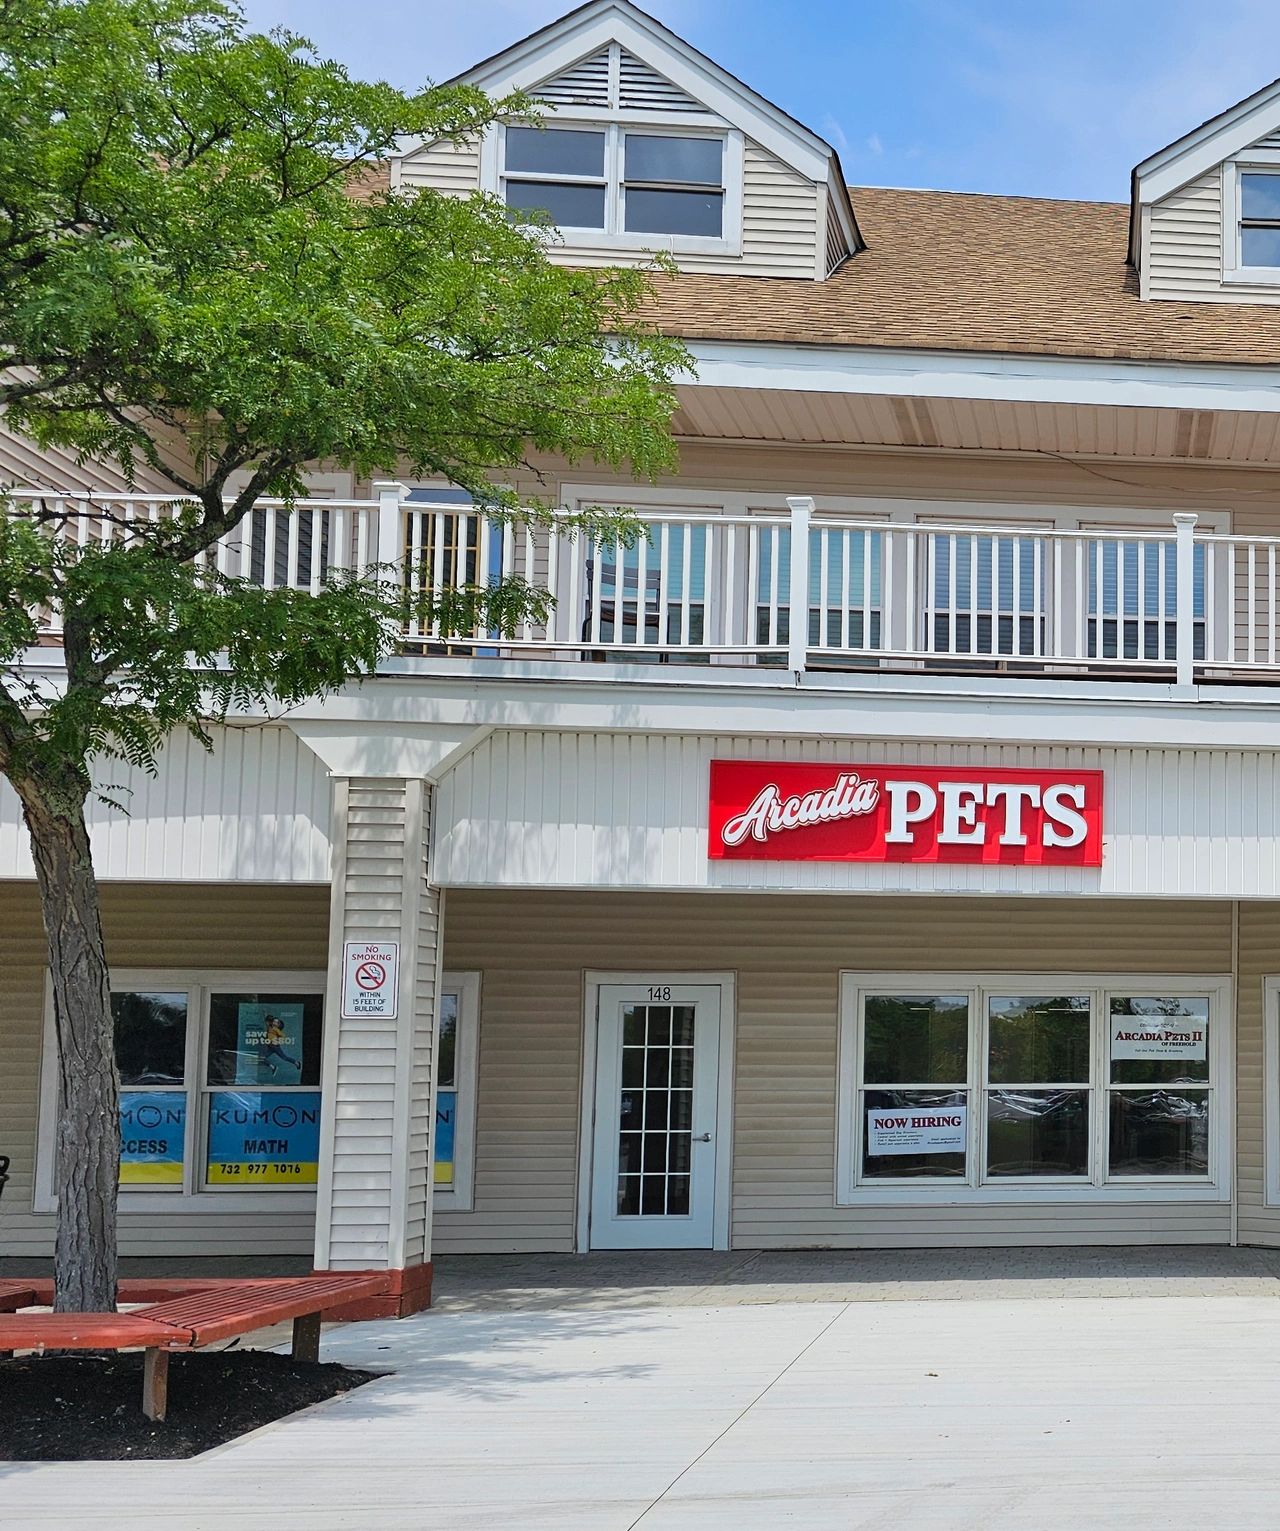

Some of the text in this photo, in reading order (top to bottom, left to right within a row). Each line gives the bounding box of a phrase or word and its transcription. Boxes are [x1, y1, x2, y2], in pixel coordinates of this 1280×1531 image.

[721, 772, 1088, 848] Arcadia PETS
[351, 953, 392, 961] SMOKING
[647, 986, 671, 1001] 148
[245, 1038, 259, 1046] up
[260, 1037, 271, 1045] to
[1115, 1030, 1163, 1041] ARCADIA
[1192, 1031, 1203, 1041] II
[119, 1105, 181, 1128] MON
[215, 1105, 318, 1128] KUMON
[874, 1116, 962, 1130] NOW HIRING
[243, 1139, 289, 1154] MATH
[220, 1164, 240, 1175] 732
[247, 1164, 268, 1175] 977
